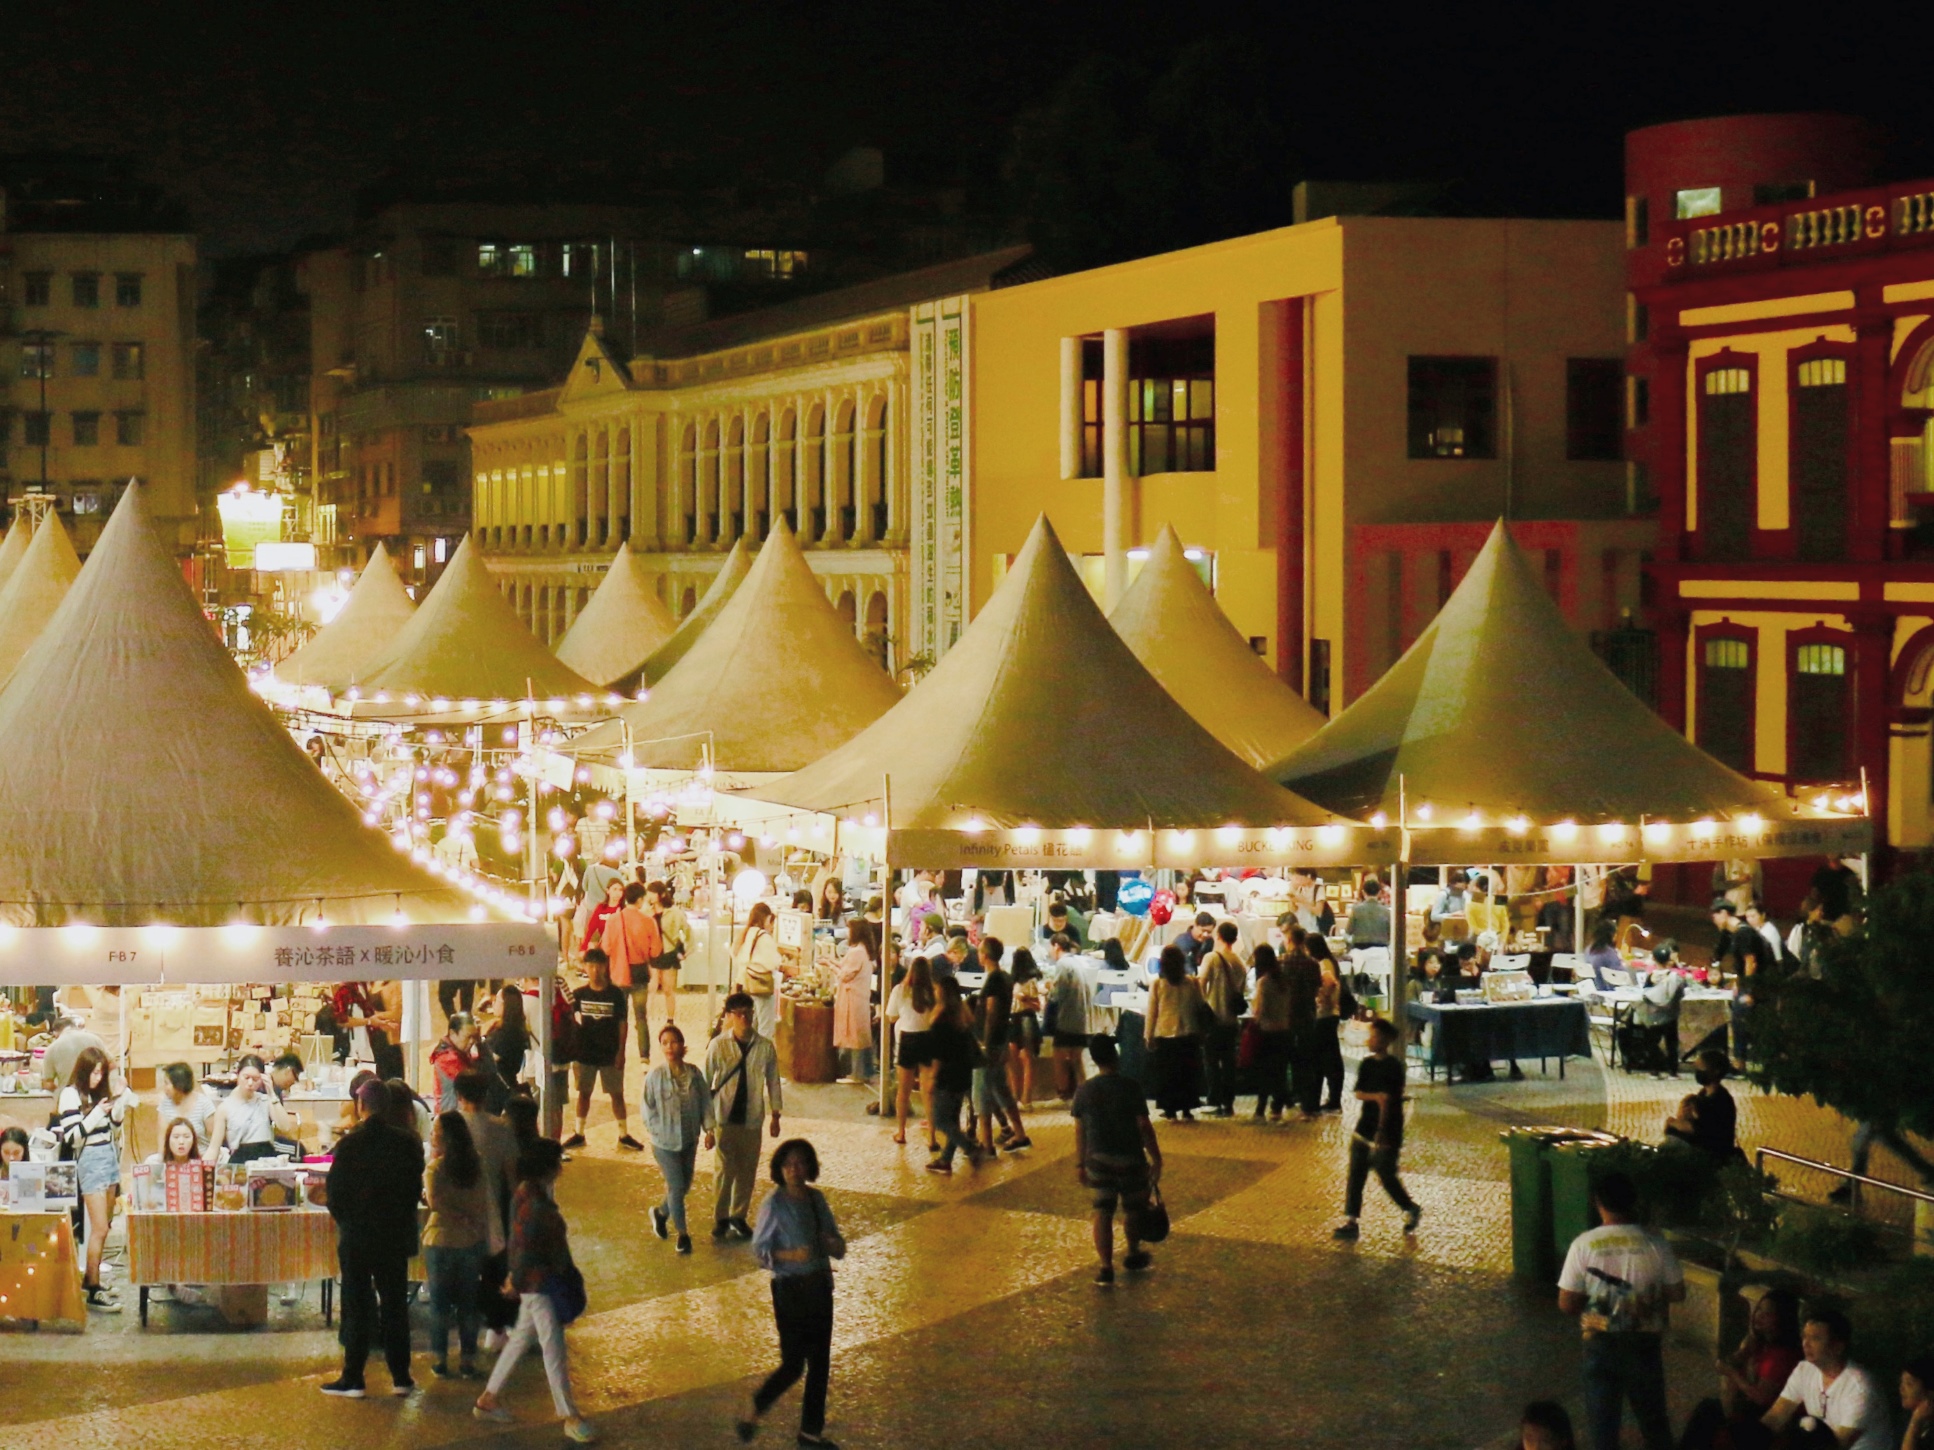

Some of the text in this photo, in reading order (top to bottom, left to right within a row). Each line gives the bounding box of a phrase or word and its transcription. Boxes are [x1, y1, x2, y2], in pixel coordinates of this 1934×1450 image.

[960, 843, 1001, 858] Infinity
[1004, 843, 1038, 855] Petals
[1238, 840, 1280, 852] BUCKE
[274, 945, 356, 967] 養沁茶語
[375, 943, 455, 965] 暖沁小食
